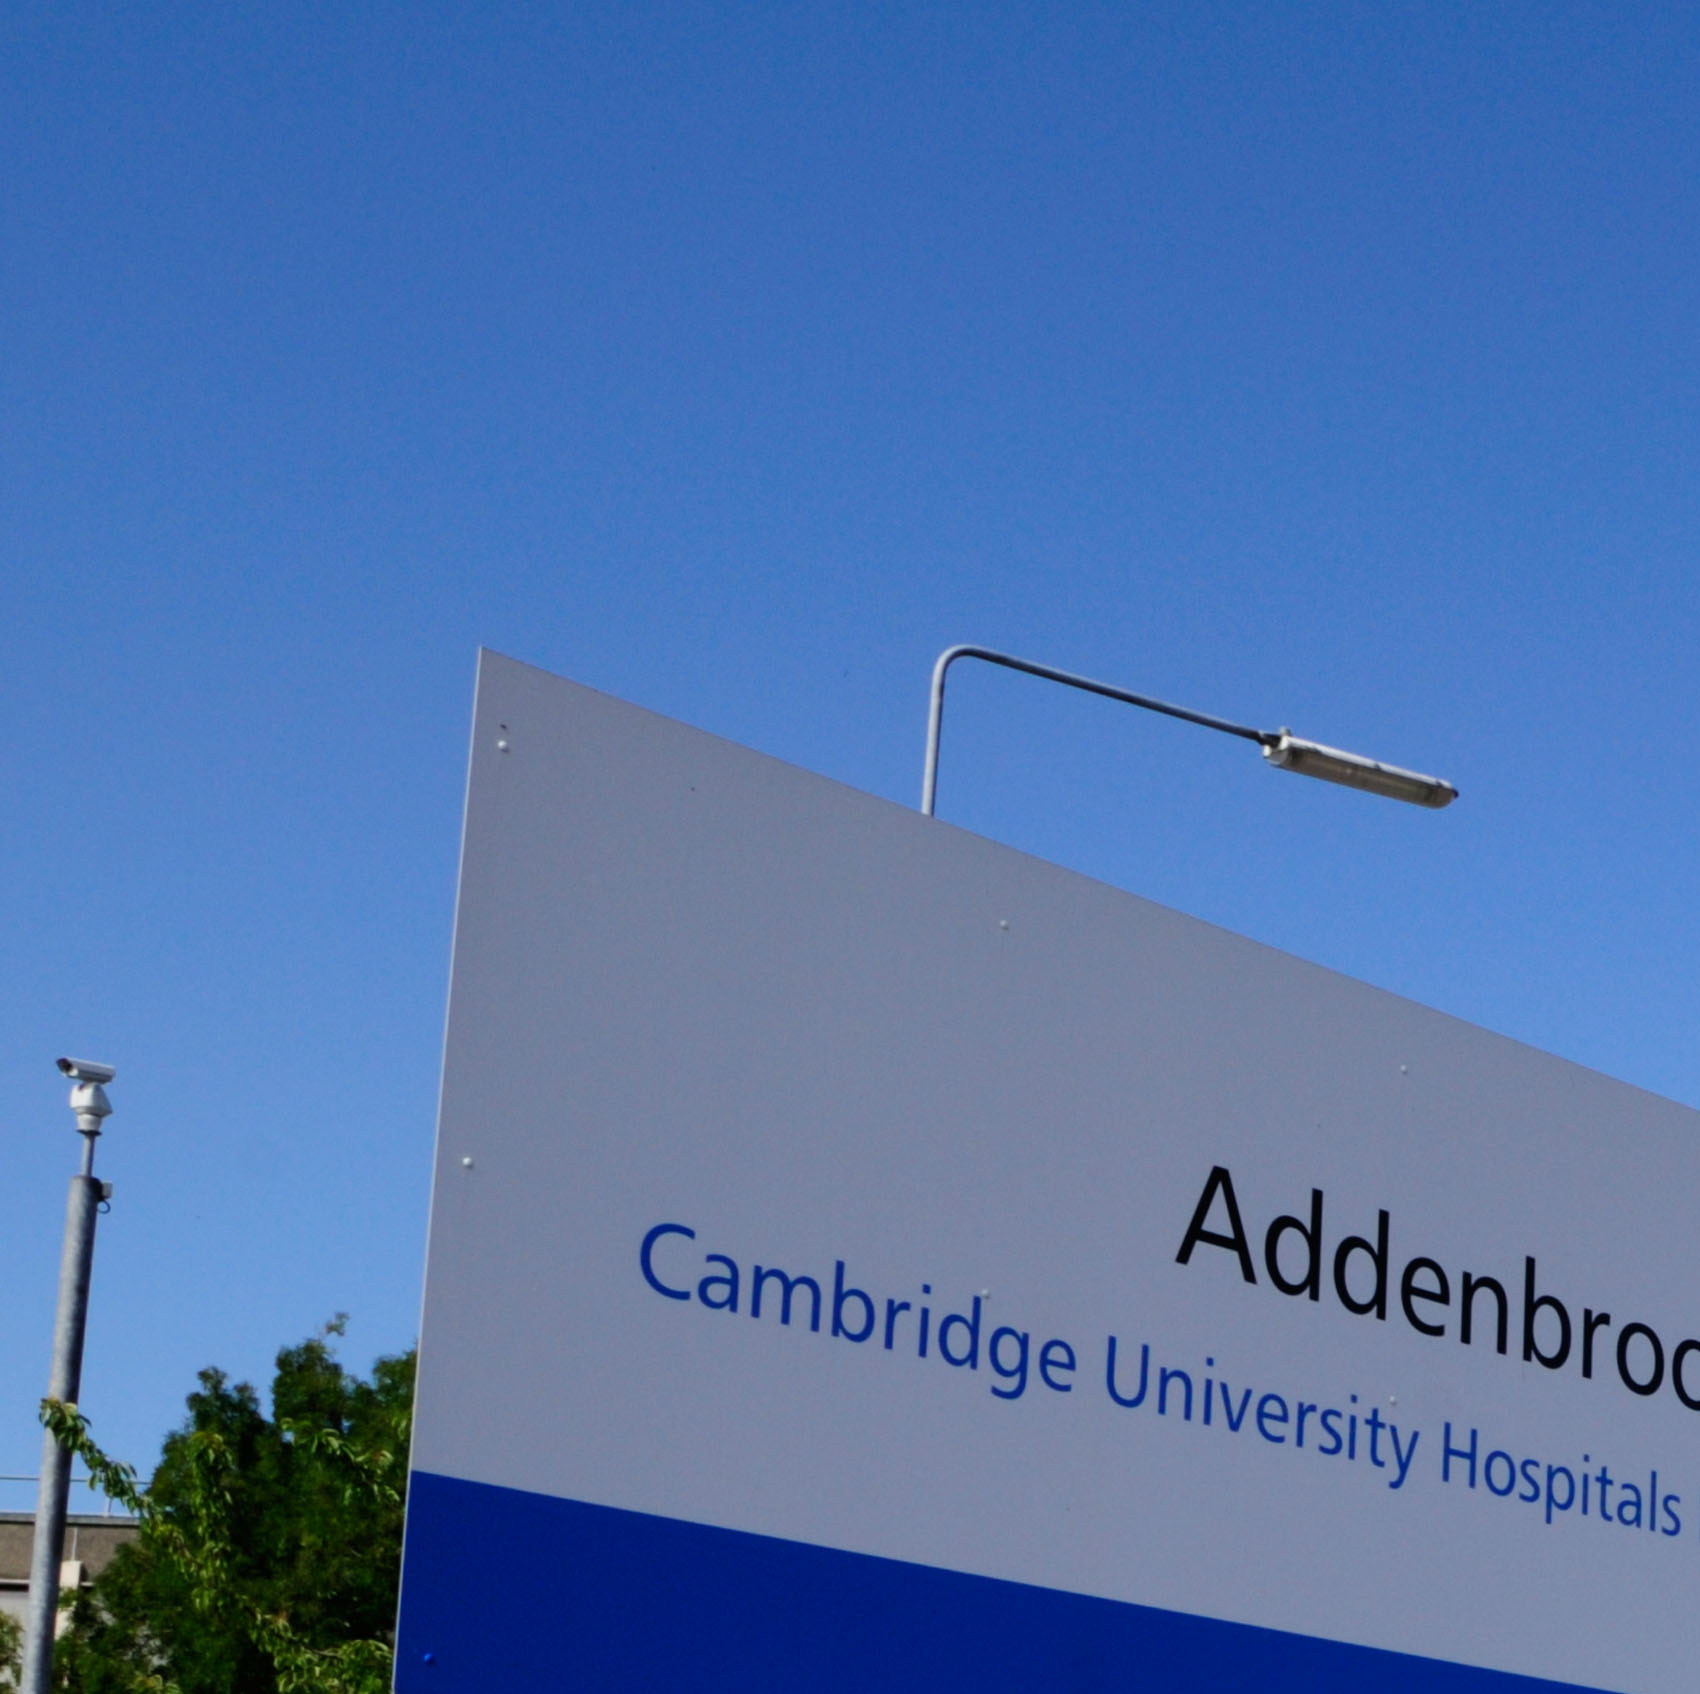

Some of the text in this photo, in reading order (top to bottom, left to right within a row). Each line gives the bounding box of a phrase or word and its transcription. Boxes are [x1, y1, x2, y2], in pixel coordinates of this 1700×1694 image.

[636, 1219, 1079, 1402] Cambridge
[1103, 1333, 1422, 1493] University
[1438, 1418, 1685, 1540] Hospitals
